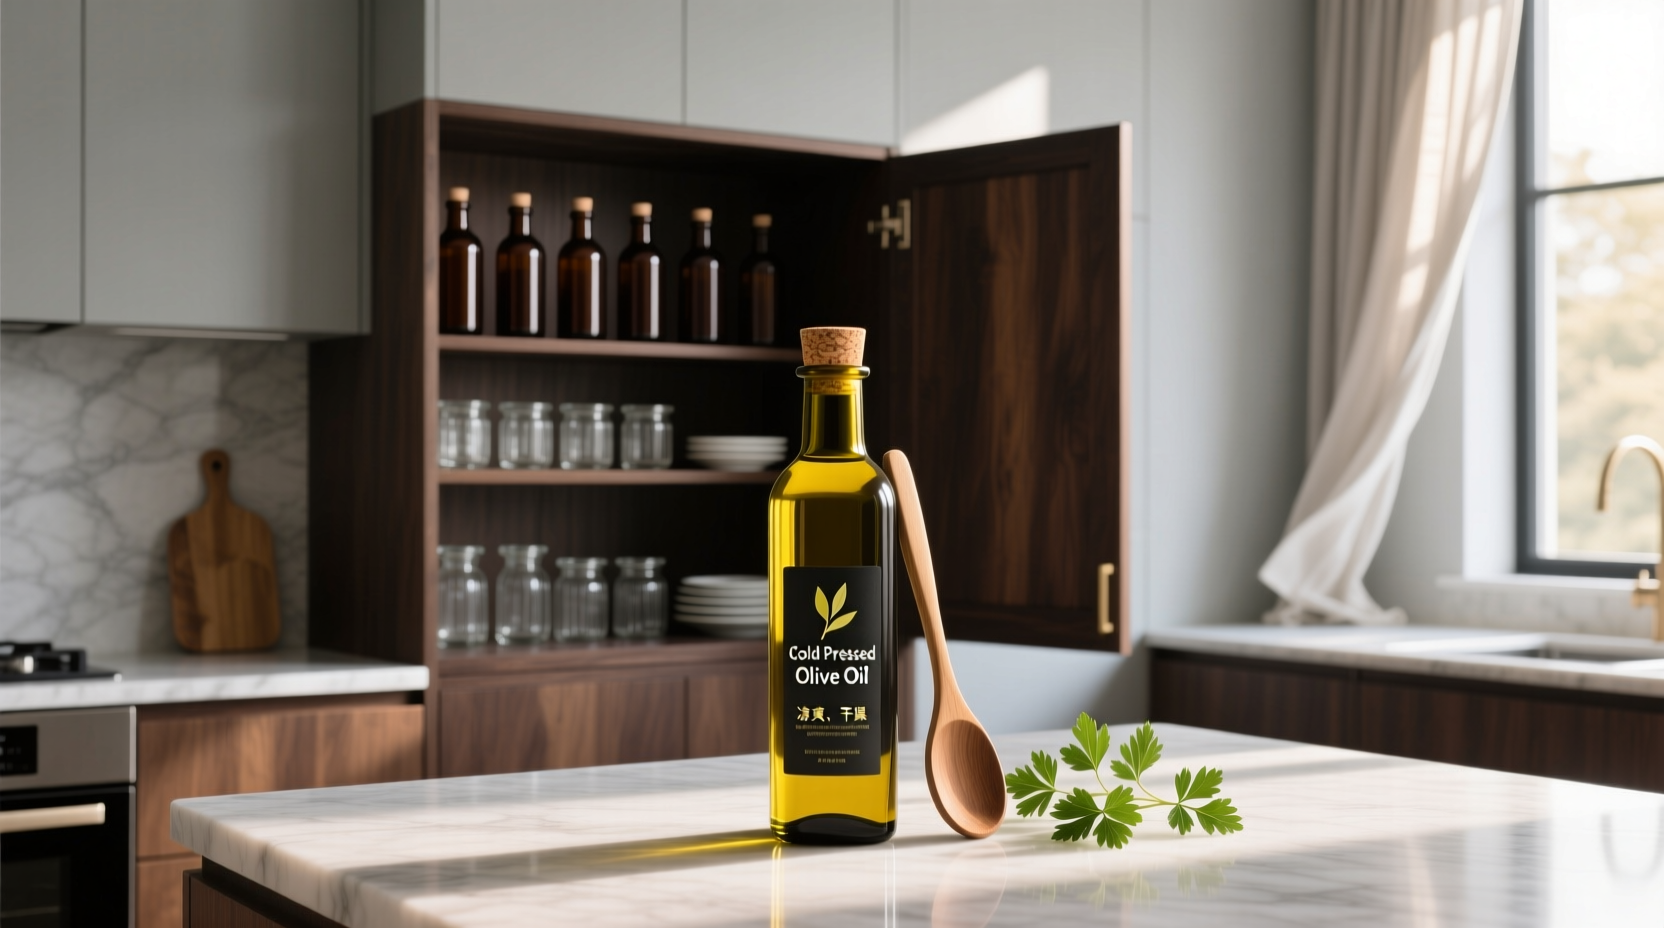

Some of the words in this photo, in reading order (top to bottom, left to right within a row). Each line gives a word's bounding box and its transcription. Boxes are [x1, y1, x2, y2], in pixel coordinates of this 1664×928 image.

[789, 645, 820, 661] Cold
[824, 645, 876, 661] Pressed
[795, 666, 840, 685] Olive
[844, 665, 869, 685] Oil
